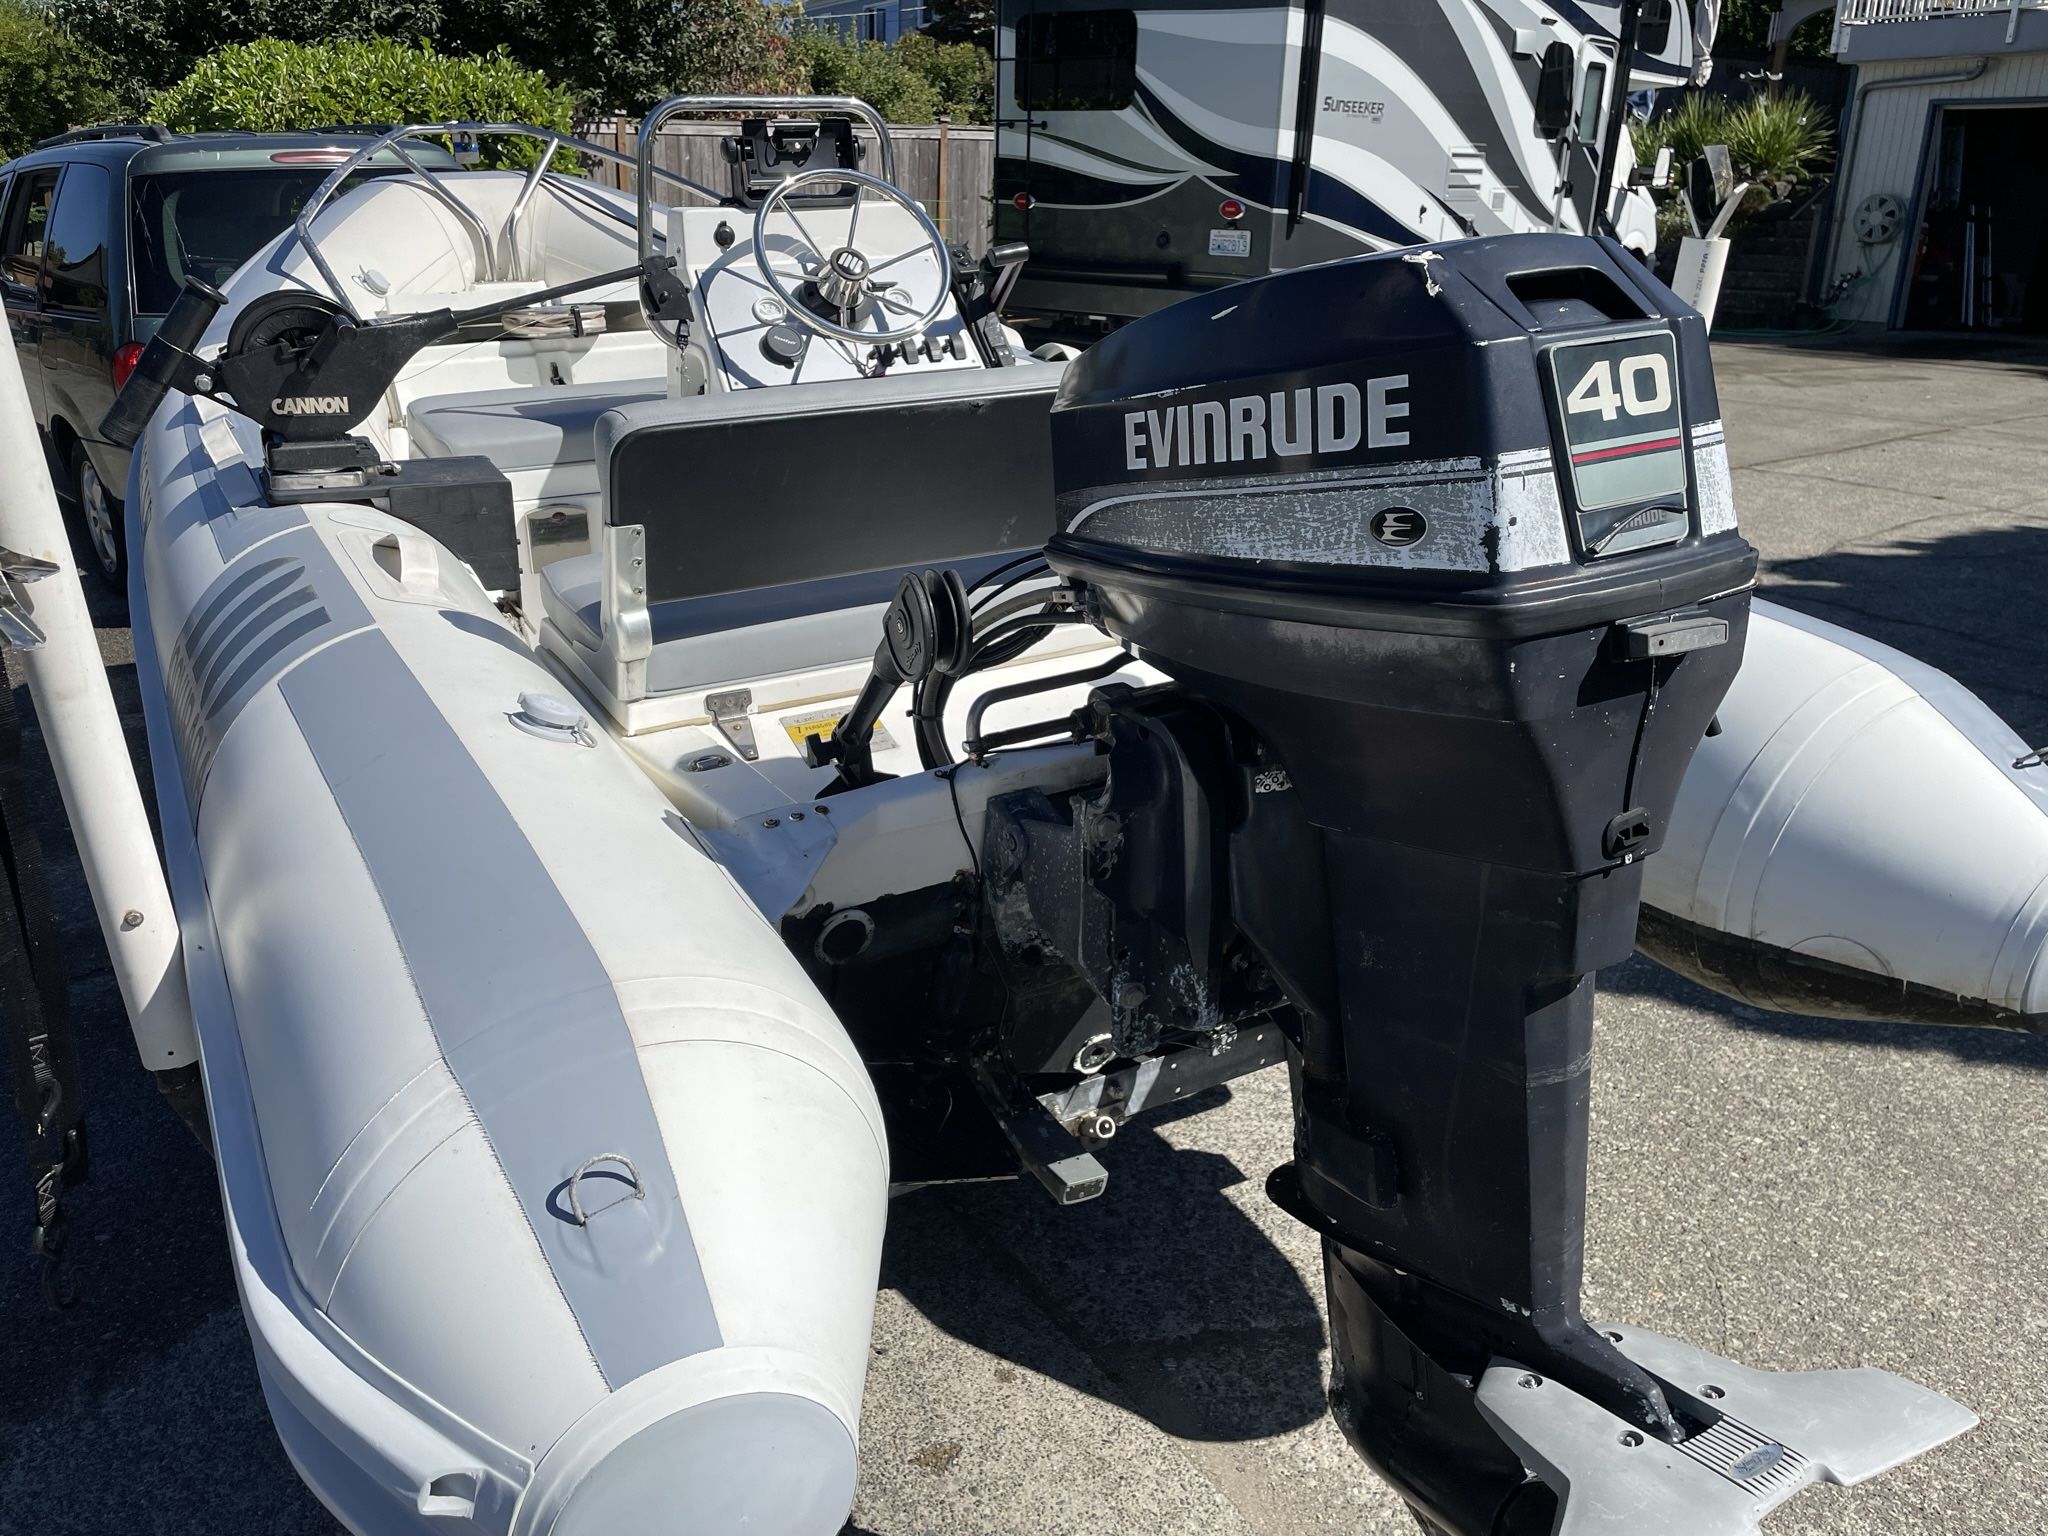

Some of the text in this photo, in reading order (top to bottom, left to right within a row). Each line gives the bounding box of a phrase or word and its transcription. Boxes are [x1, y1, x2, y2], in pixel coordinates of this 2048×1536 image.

[1323, 96, 1385, 115] SUNSEEKER
[271, 396, 349, 415] CANNON
[1566, 353, 1672, 421] 40
[1124, 374, 1410, 471] EVINRUDE
